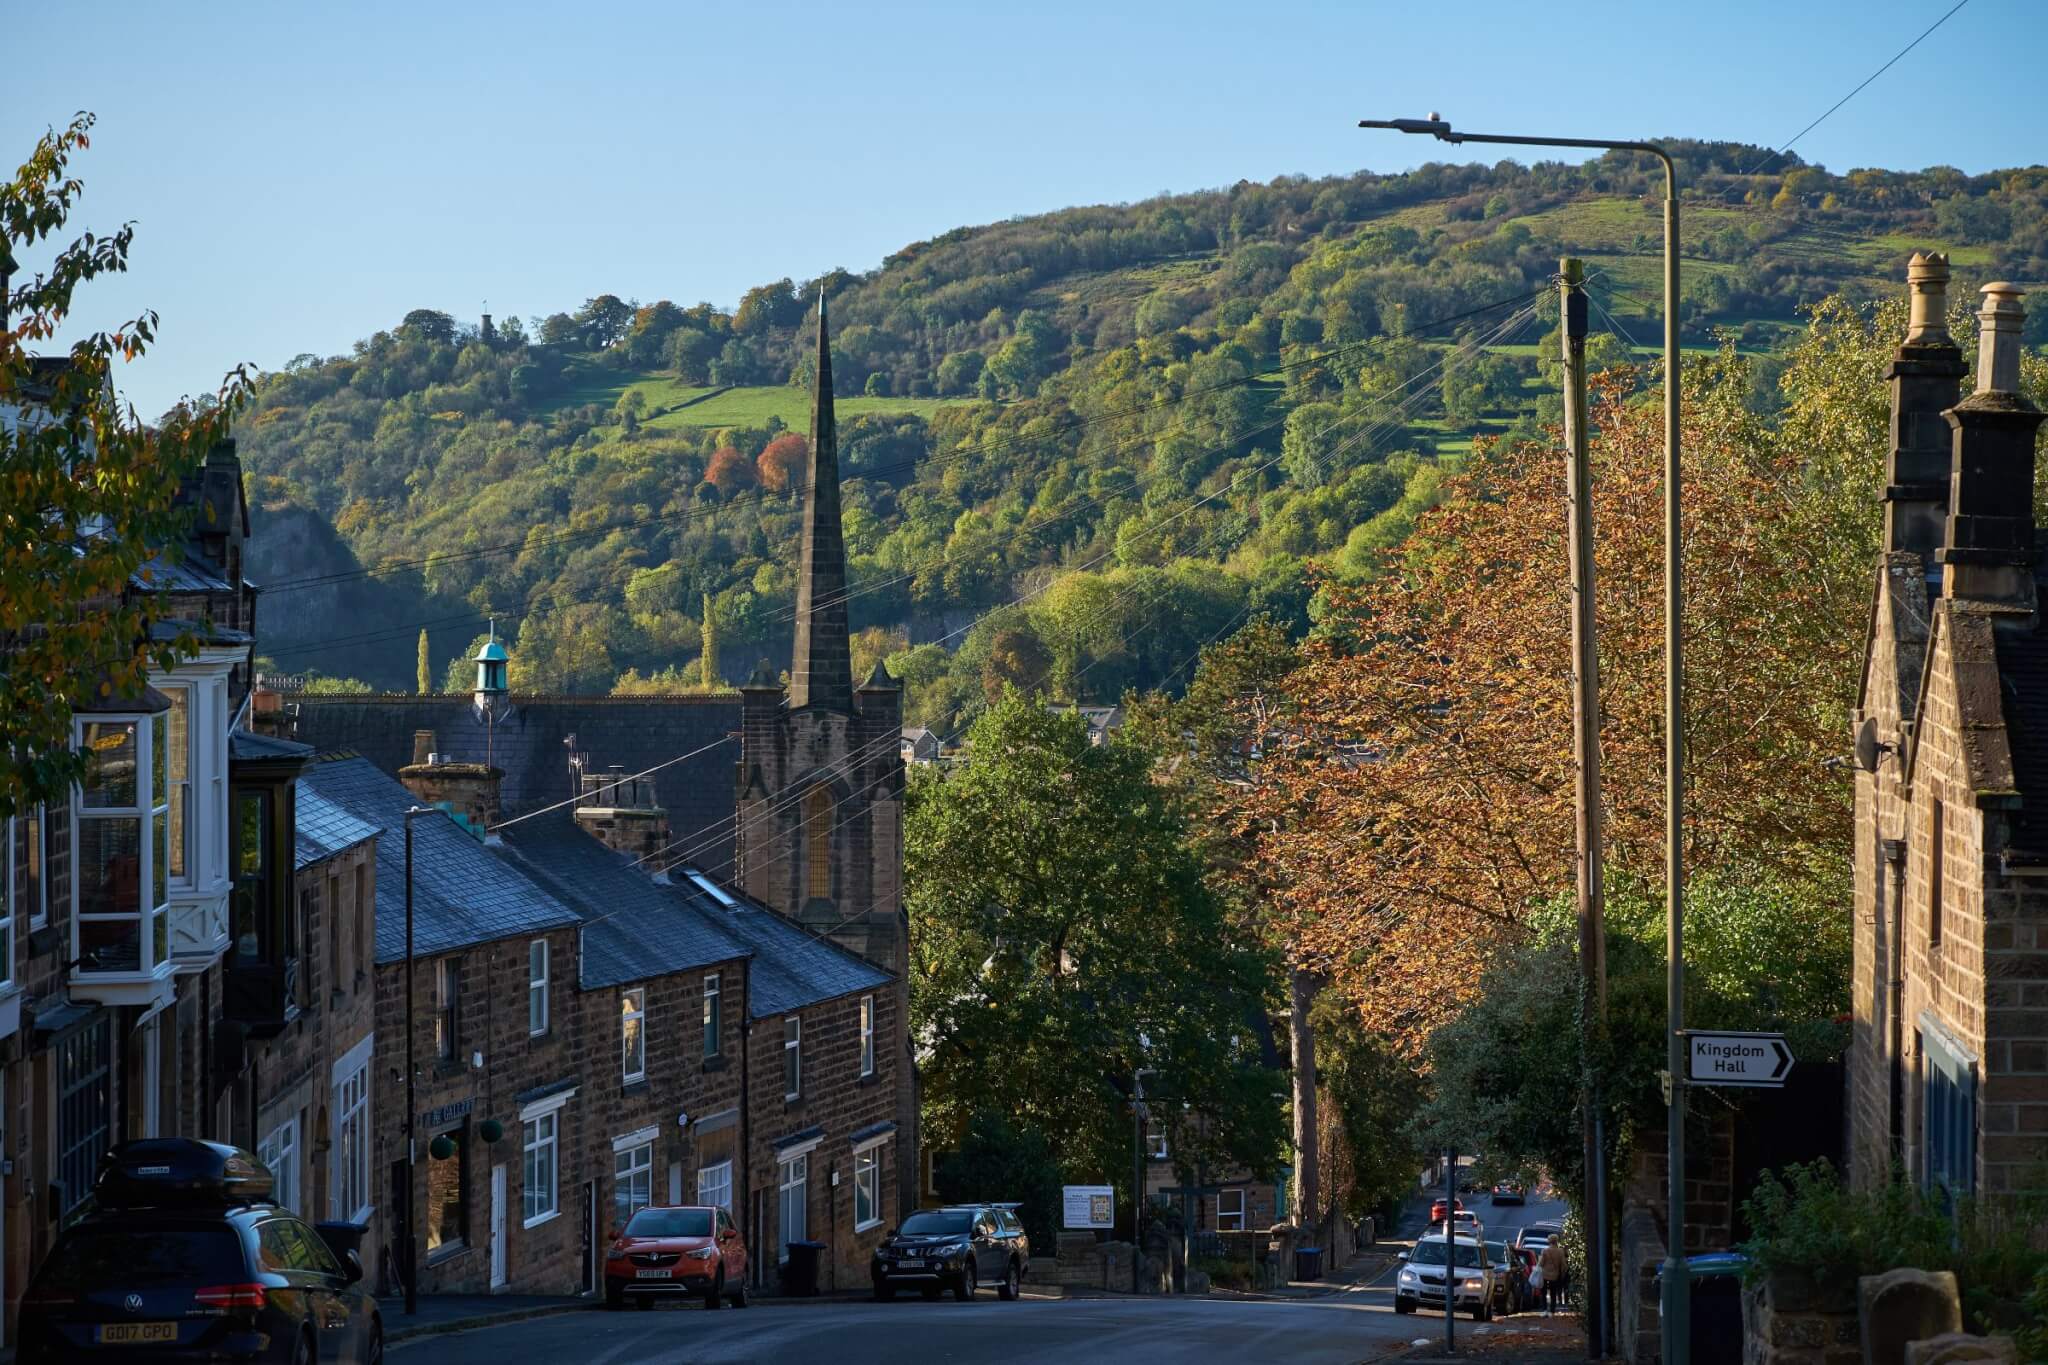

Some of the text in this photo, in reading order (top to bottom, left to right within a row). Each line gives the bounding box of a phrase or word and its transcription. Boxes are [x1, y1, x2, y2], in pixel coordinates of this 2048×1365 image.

[1696, 1042, 1764, 1058] Kingdom
[1714, 1059, 1746, 1073] Hall
[105, 1325, 138, 1340] GD17
